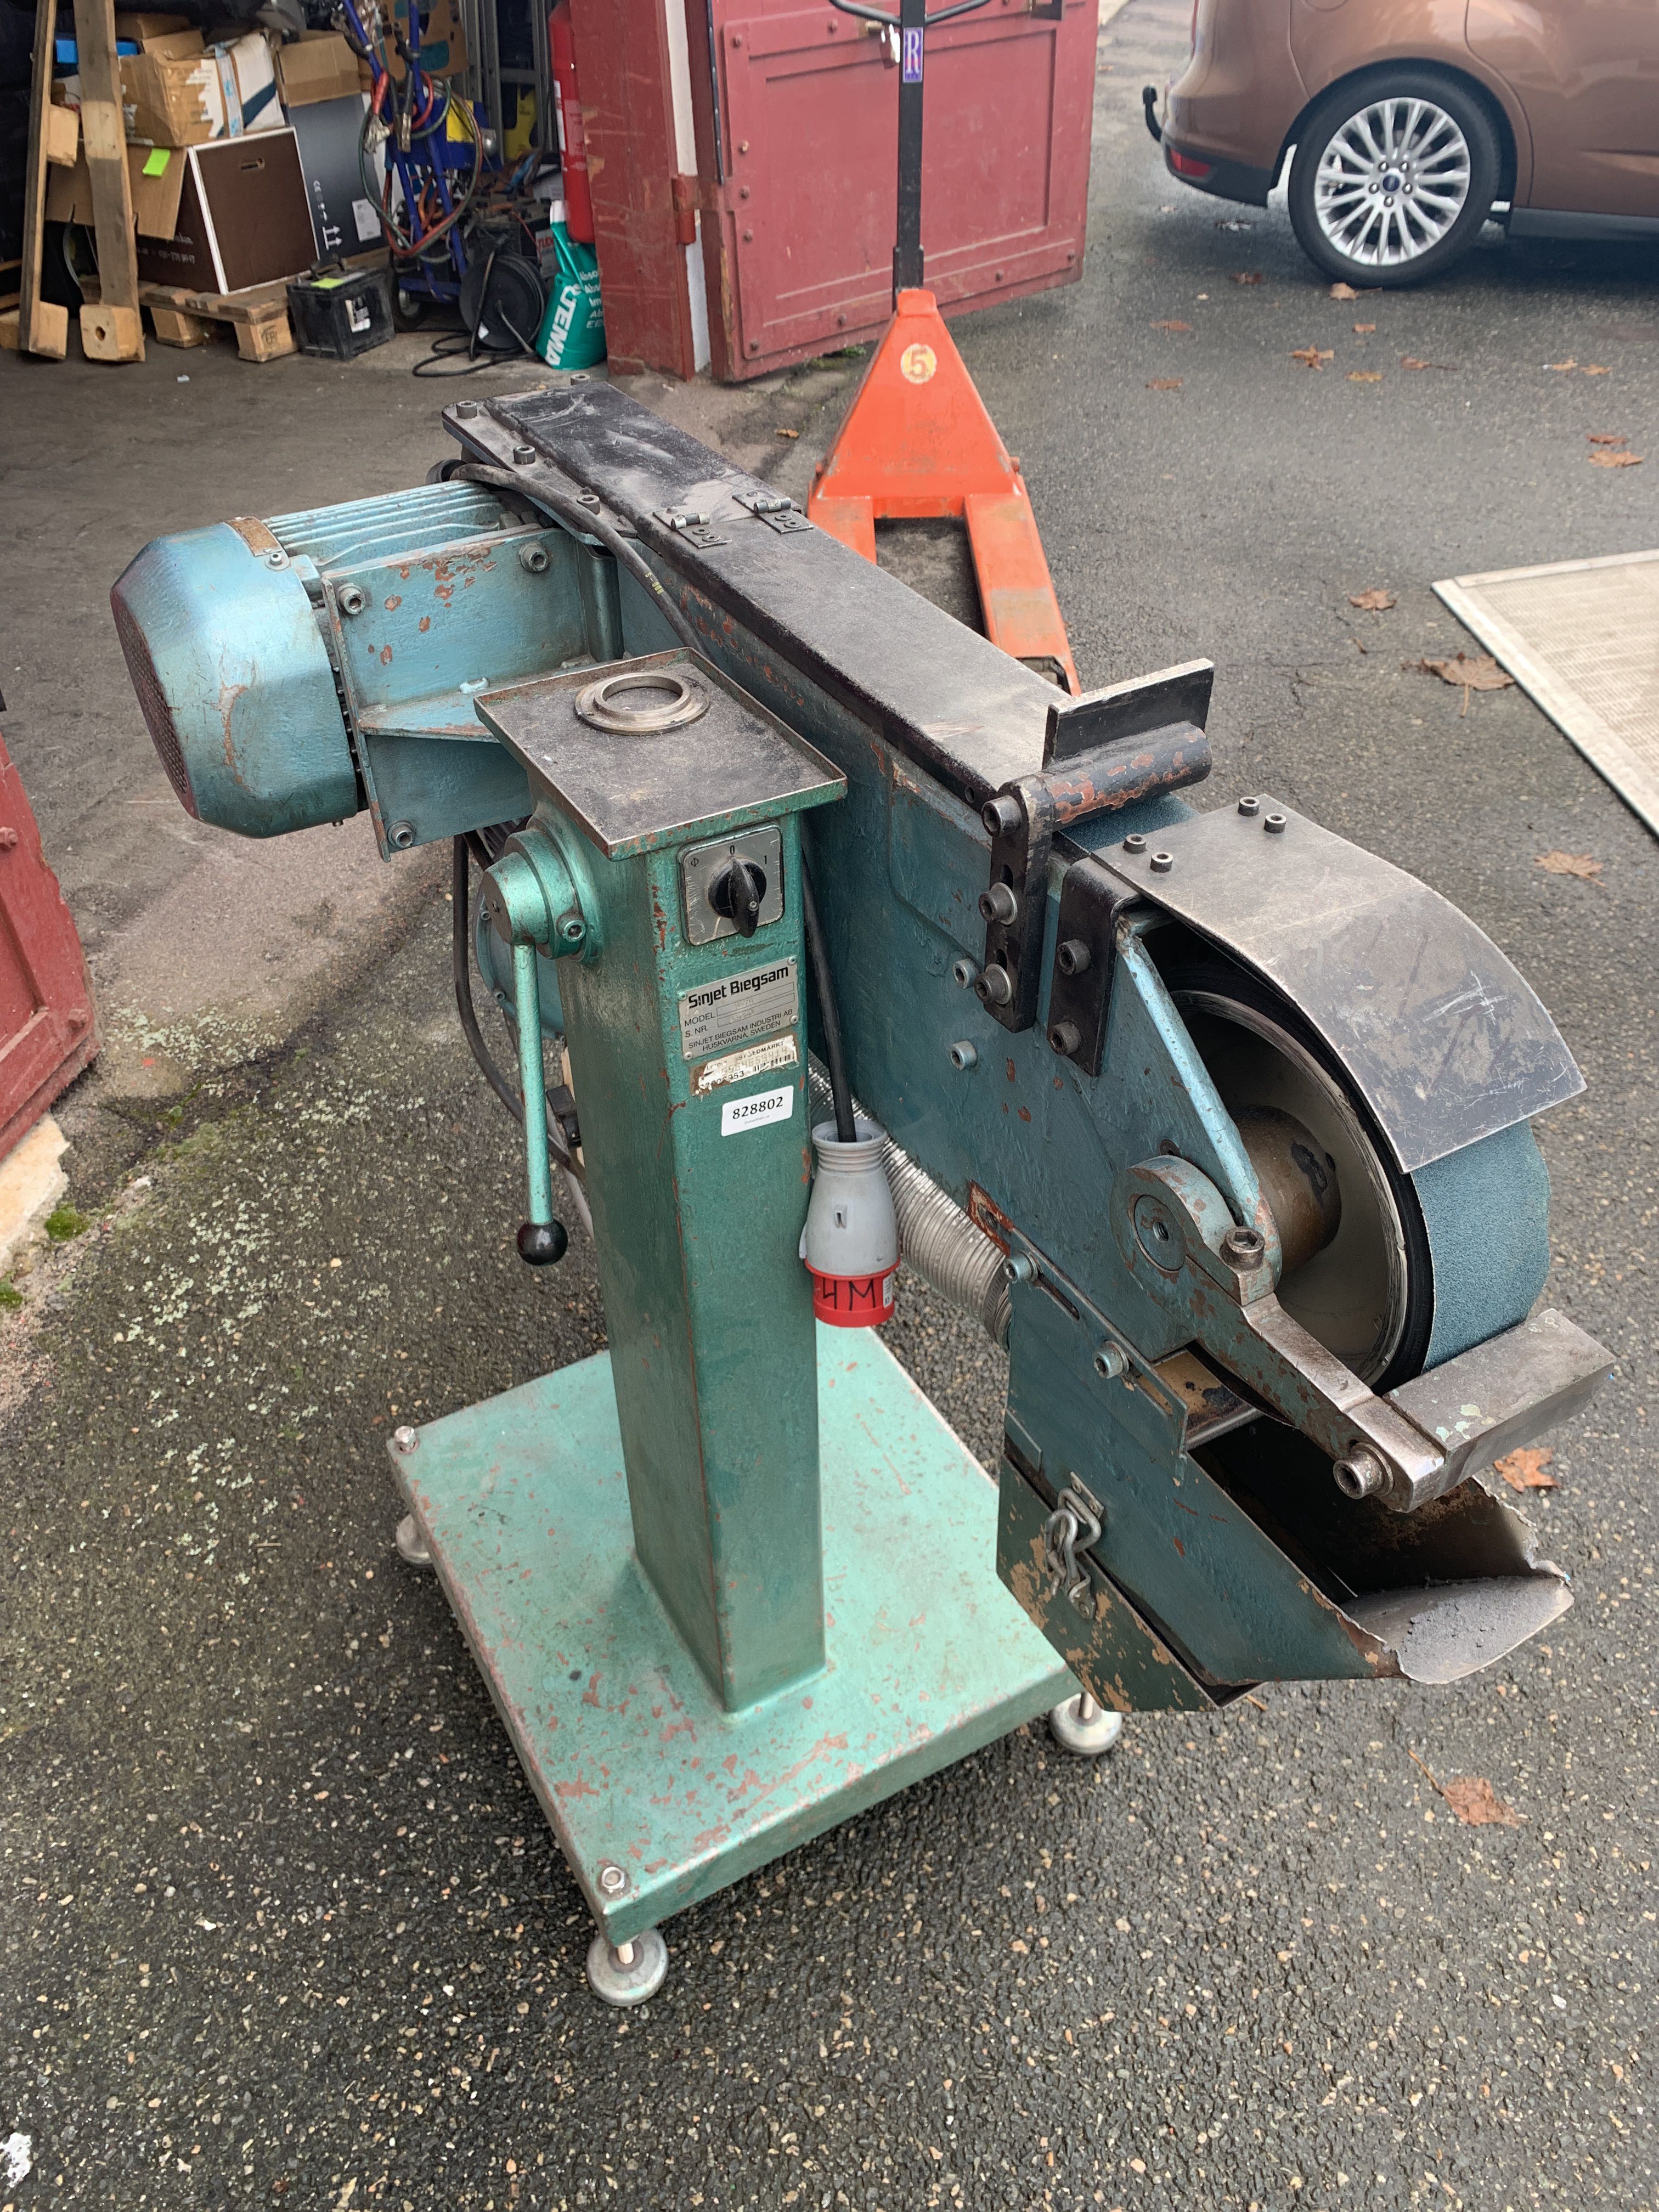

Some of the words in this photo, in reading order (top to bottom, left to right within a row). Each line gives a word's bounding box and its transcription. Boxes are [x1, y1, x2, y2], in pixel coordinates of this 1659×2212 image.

[910, 348, 928, 378] 5
[688, 985, 727, 1009] Sinjet
[730, 967, 788, 995] Biegsam
[684, 1012, 715, 1027] MODEL
[689, 1036, 713, 1049] SINJET
[715, 1025, 748, 1041] BIEGSAM
[750, 1014, 782, 1029] INDUSTRI
[783, 1009, 793, 1017] AB
[750, 1020, 781, 1036] SWEDEN
[732, 1096, 783, 1120] 828802
